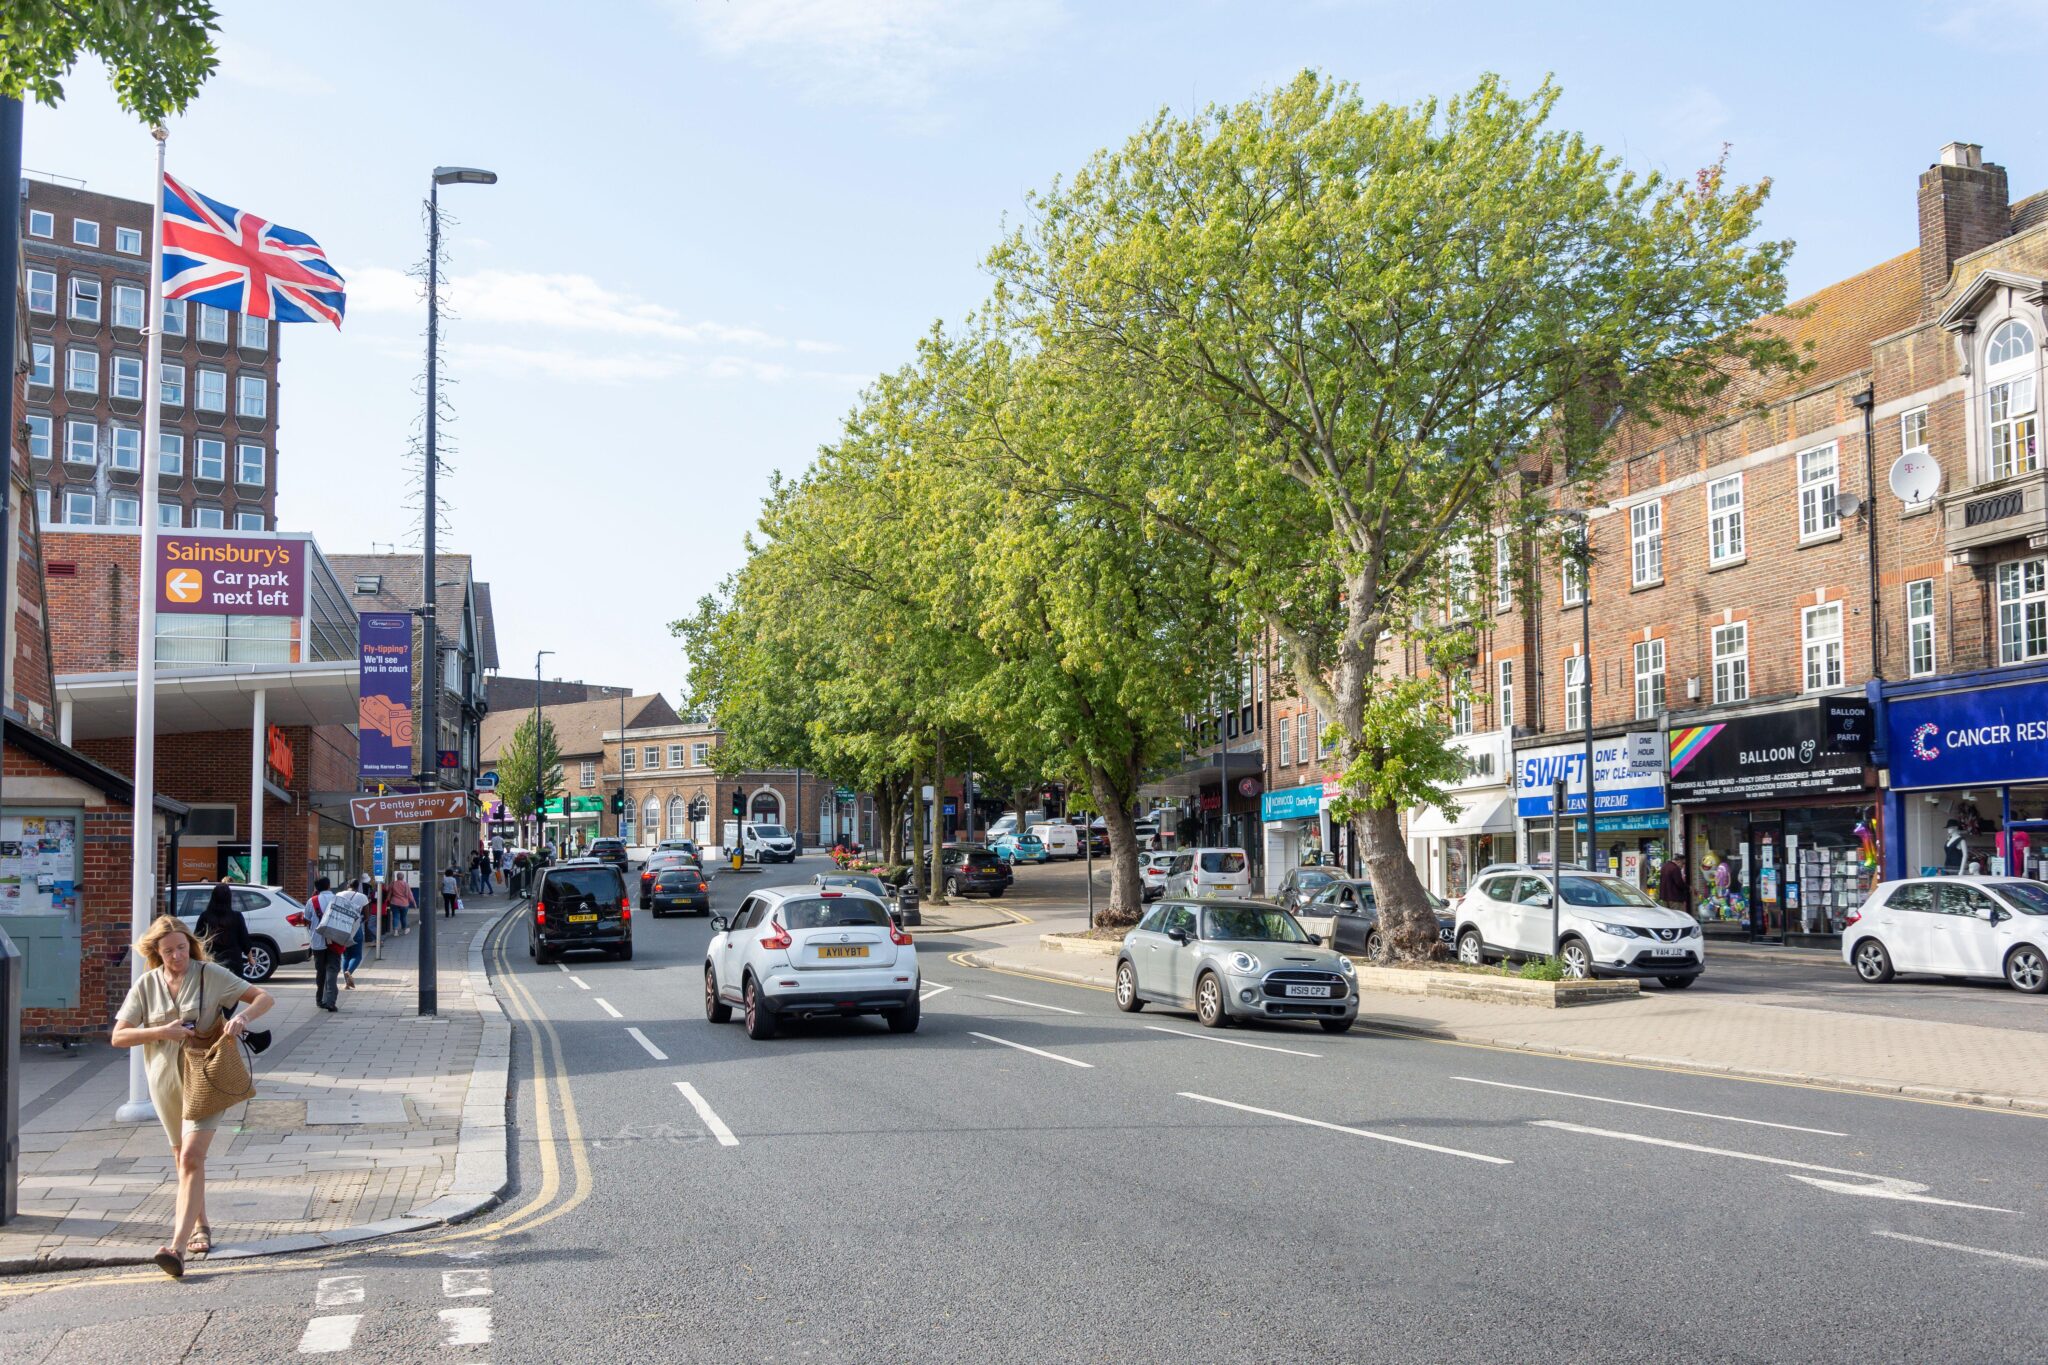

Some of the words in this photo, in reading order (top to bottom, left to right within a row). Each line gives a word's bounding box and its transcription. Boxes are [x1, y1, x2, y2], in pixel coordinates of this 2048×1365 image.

[166, 541, 290, 568] Sainsbury's
[213, 569, 244, 585] Car
[247, 571, 290, 589] park
[212, 590, 253, 605] next
[257, 590, 290, 606] left
[363, 644, 409, 655] Fly-tipping?
[364, 655, 383, 664] We'll
[384, 656, 398, 664] see
[364, 665, 378, 674] you
[379, 664, 387, 673] in
[388, 664, 409, 673] court
[1830, 707, 1866, 716] BALLOON
[1836, 733, 1861, 741] PARTY
[1946, 724, 2011, 748] CANCER
[2016, 720, 2048, 742] RES
[1639, 736, 1653, 745] ONE
[1595, 748, 1618, 763] ONE
[1637, 748, 1655, 756] HOUR
[1739, 746, 1796, 765] BALLOON
[1631, 760, 1663, 768] CLEANERS
[1523, 752, 1587, 789] SWIFT
[1594, 768, 1611, 782] DRY
[1718, 778, 1735, 786] ROUND
[1738, 776, 1755, 784] FANCY
[1754, 774, 1771, 783] DRESS
[1773, 771, 1809, 781] ACCESSORIES
[1811, 769, 1826, 778] WIGS
[1827, 766, 1862, 777] FACEPAINTS
[1692, 787, 1721, 796] PARTYWARE
[1722, 785, 1745, 794] BALLOON
[1745, 783, 1776, 792] DECORATION
[1776, 780, 1798, 789] SERVICE
[1800, 778, 1821, 787] HELIUM
[1820, 777, 1834, 786] HIRE
[380, 800, 415, 810] Bentley
[418, 797, 446, 807] Priory
[1295, 796, 1308, 808] Charity
[1567, 798, 1588, 810] LEAN
[1594, 794, 1629, 808] UPREME
[395, 809, 433, 819] Museum
[1624, 856, 1637, 867] 50
[1625, 869, 1636, 877] off
[845, 947, 863, 957] YBT
[1310, 986, 1327, 996] CPZ
